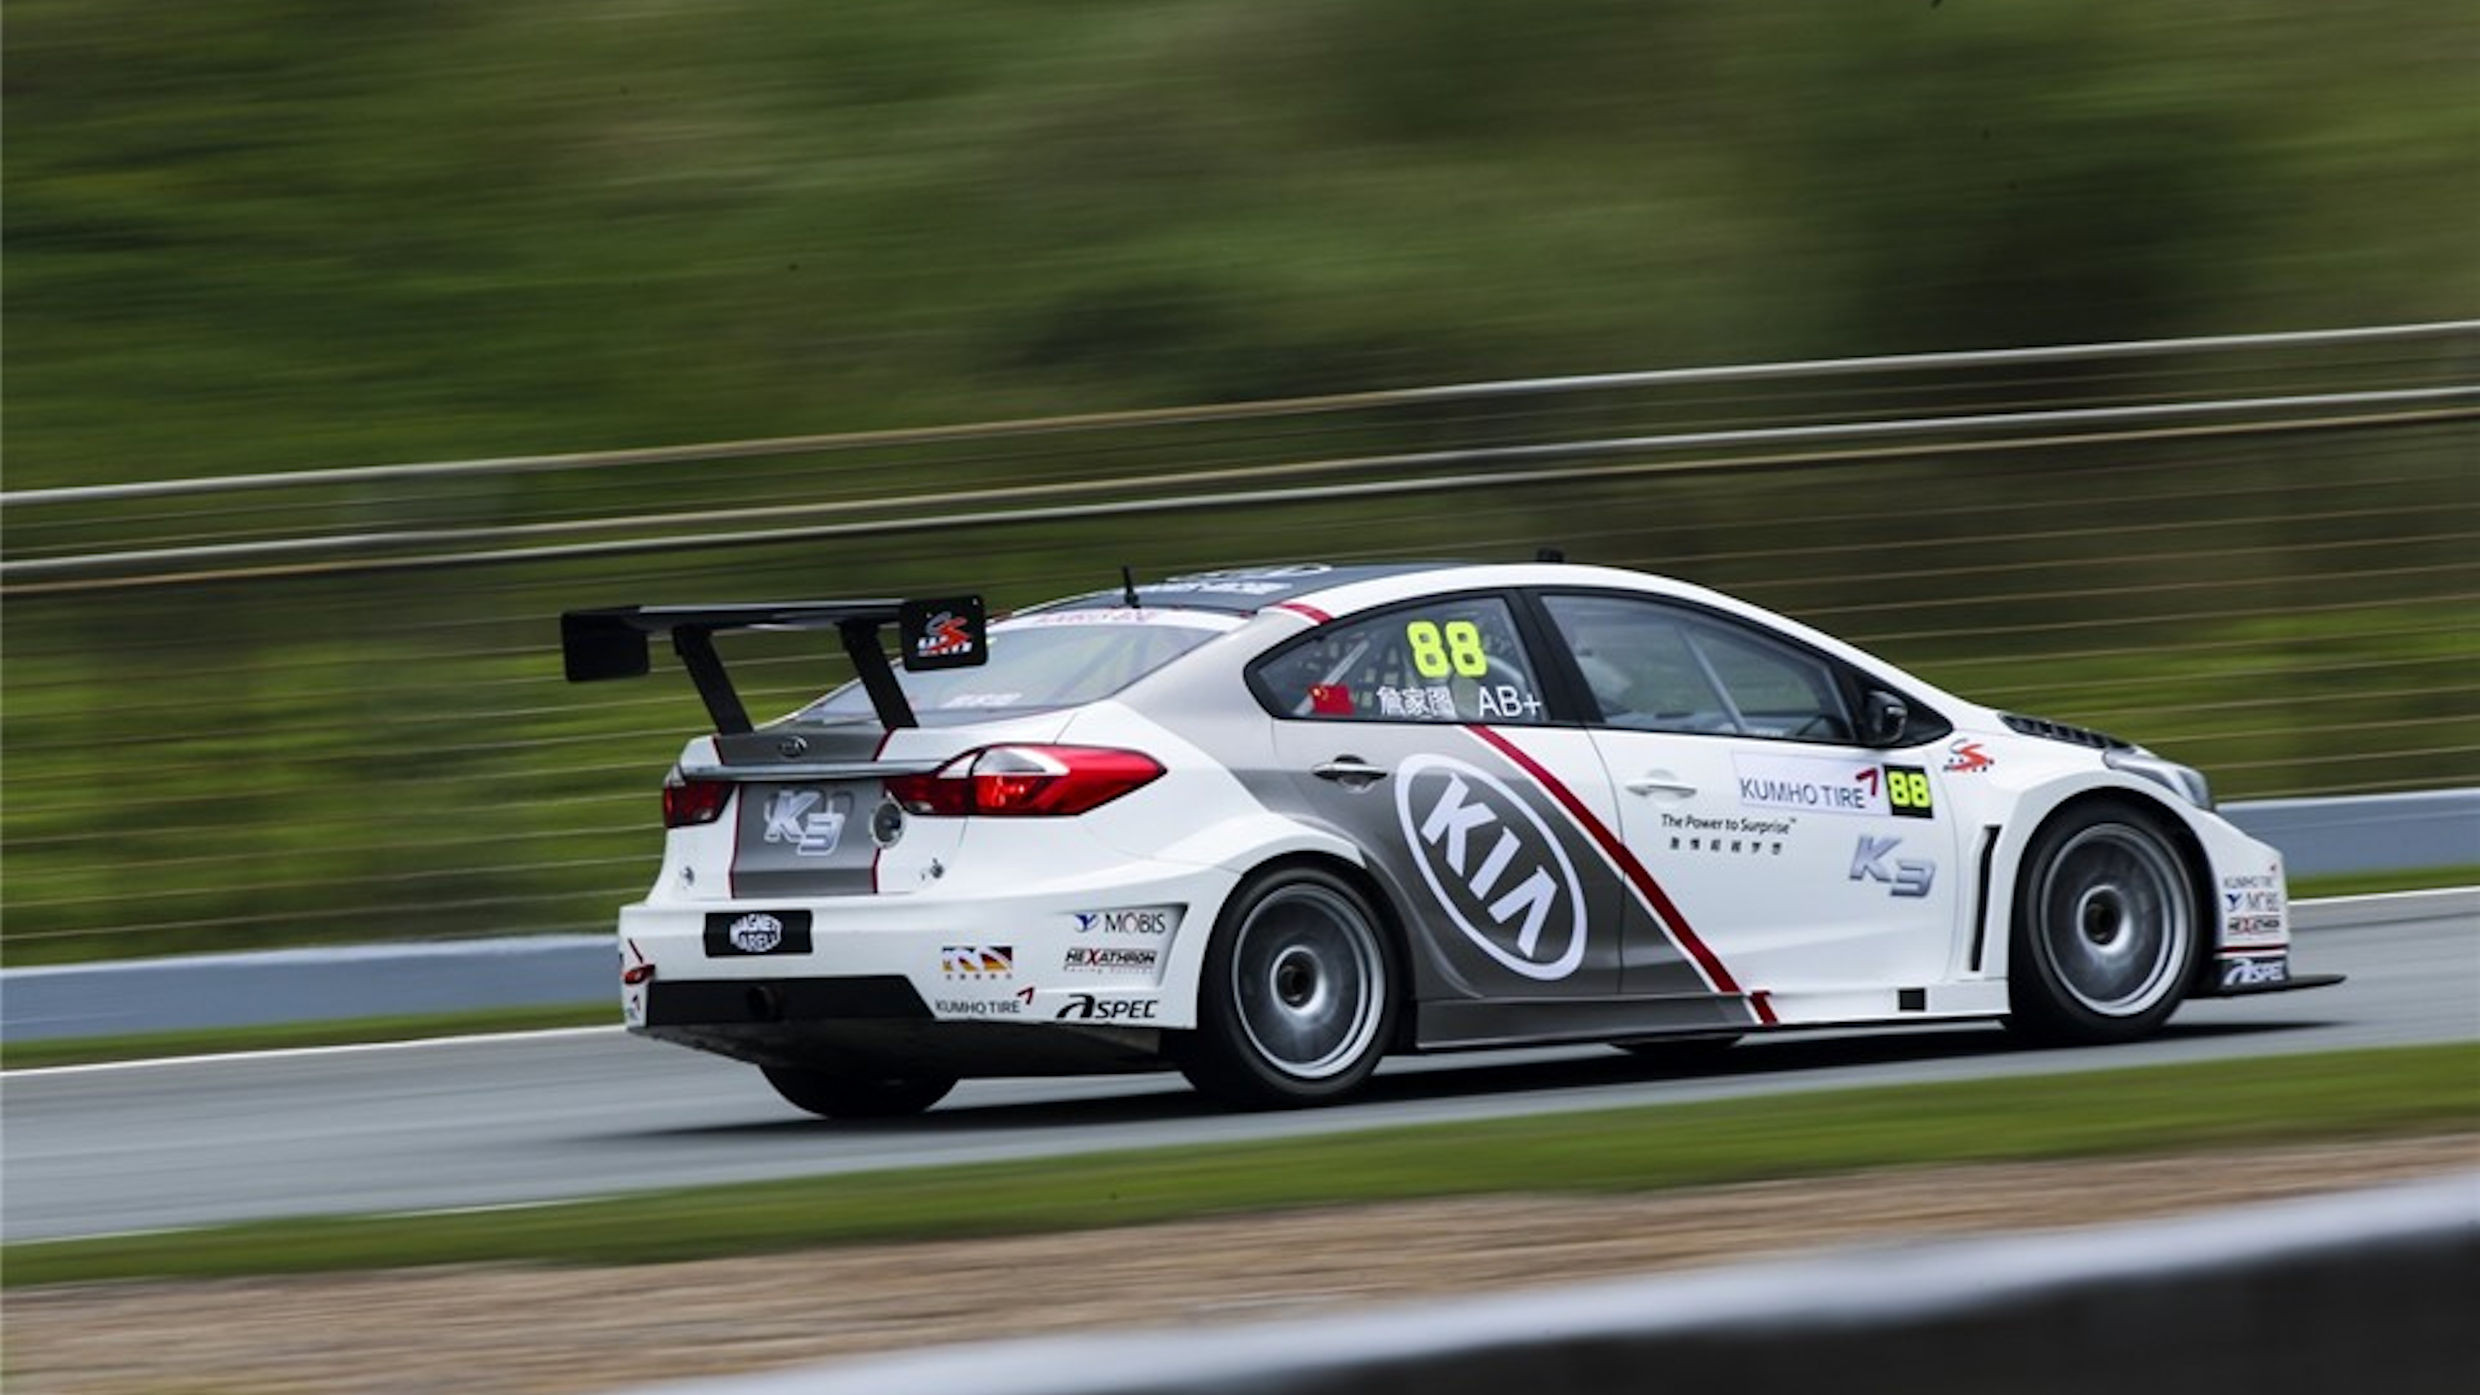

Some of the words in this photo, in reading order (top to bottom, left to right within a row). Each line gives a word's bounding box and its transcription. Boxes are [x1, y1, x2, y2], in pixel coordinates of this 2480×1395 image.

[1407, 620, 1488, 678] 88
[1478, 685, 1542, 717] AB+
[1740, 777, 1817, 805] KUMHO
[1821, 785, 1866, 809] TIRE
[1887, 770, 1930, 808] 88
[764, 789, 846, 857] K3
[1661, 813, 1683, 828] The
[1685, 815, 1723, 831] Power
[1725, 818, 1740, 832] to
[1420, 771, 1558, 958] KIA
[1849, 834, 1936, 898] K3
[1105, 914, 1167, 934] MOBIS
[934, 998, 987, 1016] KUMHO
[989, 1000, 1021, 1014] TIRE
